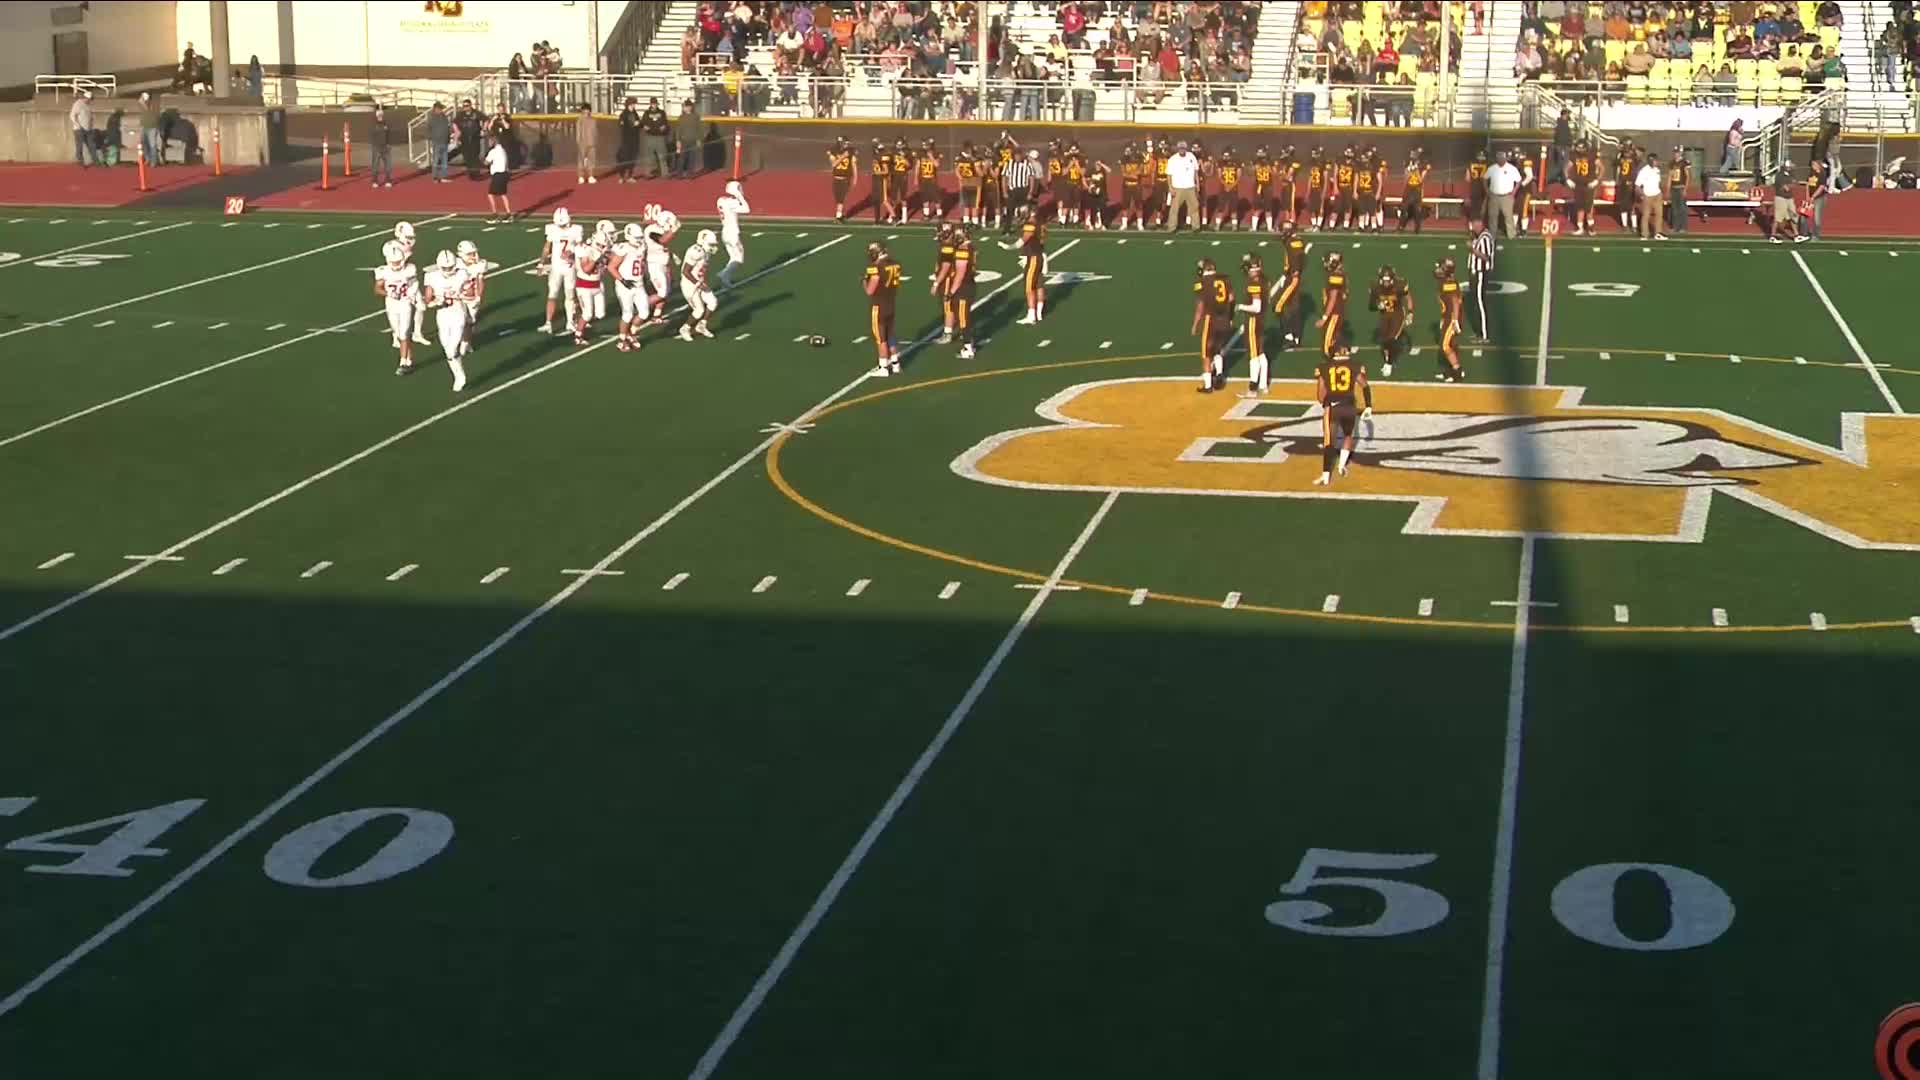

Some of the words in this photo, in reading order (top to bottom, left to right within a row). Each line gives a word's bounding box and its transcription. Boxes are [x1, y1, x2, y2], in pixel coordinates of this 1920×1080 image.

[1471, 163, 1487, 179] 57
[226, 198, 245, 214] 20
[643, 203, 662, 221] 30
[1541, 219, 1560, 235] 50
[1213, 279, 1227, 302] 3
[1328, 365, 1351, 392] 13
